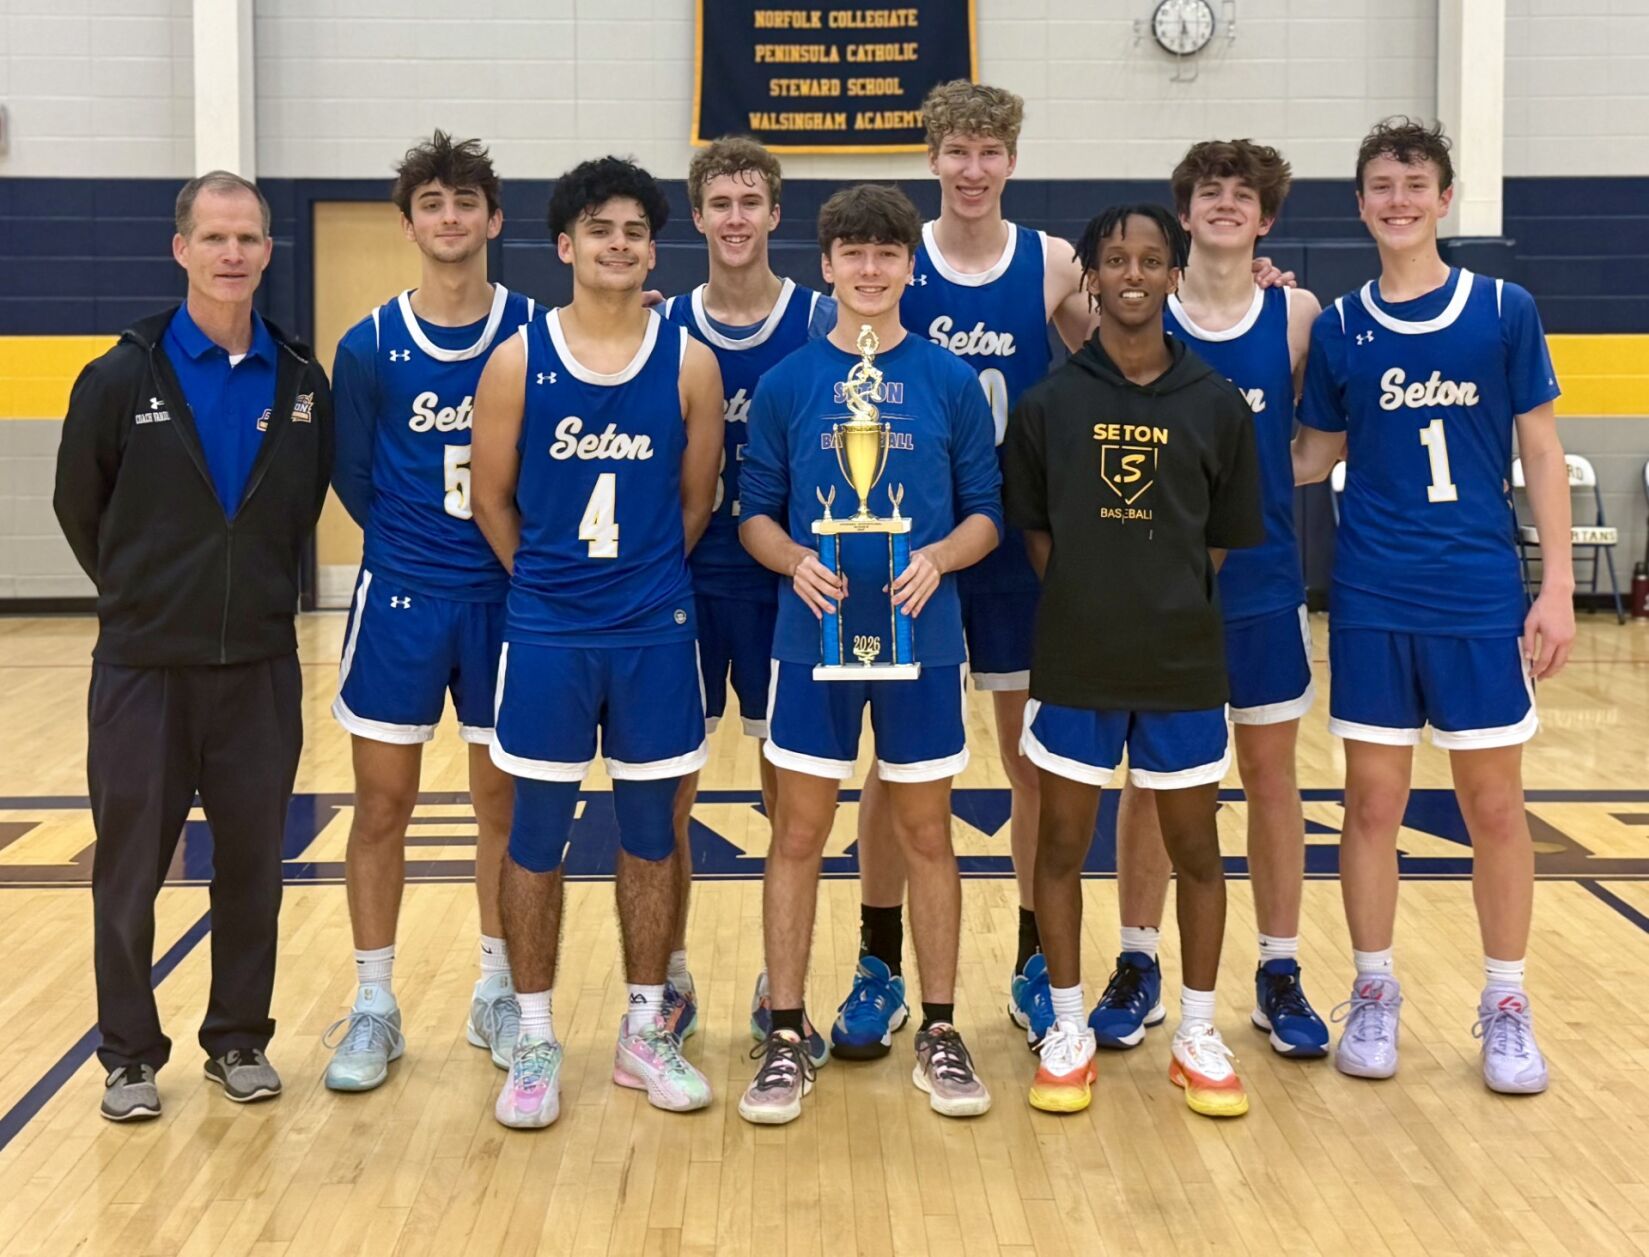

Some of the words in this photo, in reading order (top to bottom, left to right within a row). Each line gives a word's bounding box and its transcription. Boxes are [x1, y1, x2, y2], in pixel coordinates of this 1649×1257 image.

[754, 10, 822, 28] NORFOLK
[828, 9, 918, 28] COLLEGIATE
[754, 44, 840, 63] PENINSULA
[846, 43, 918, 62] CATHOLIC
[769, 78, 841, 97] STEWARD
[846, 77, 904, 96] SCHOOL
[749, 112, 847, 131] WALSINGHAM
[854, 110, 925, 130] ACADEMY
[928, 315, 1016, 357] Seton
[978, 367, 1009, 447] 0
[1379, 367, 1480, 411] Seton
[408, 391, 473, 433] Set
[549, 416, 654, 461] Seton
[1092, 423, 1168, 445] SETON
[1419, 418, 1459, 503] 1
[578, 472, 620, 559] 4
[853, 635, 881, 651] 2026
